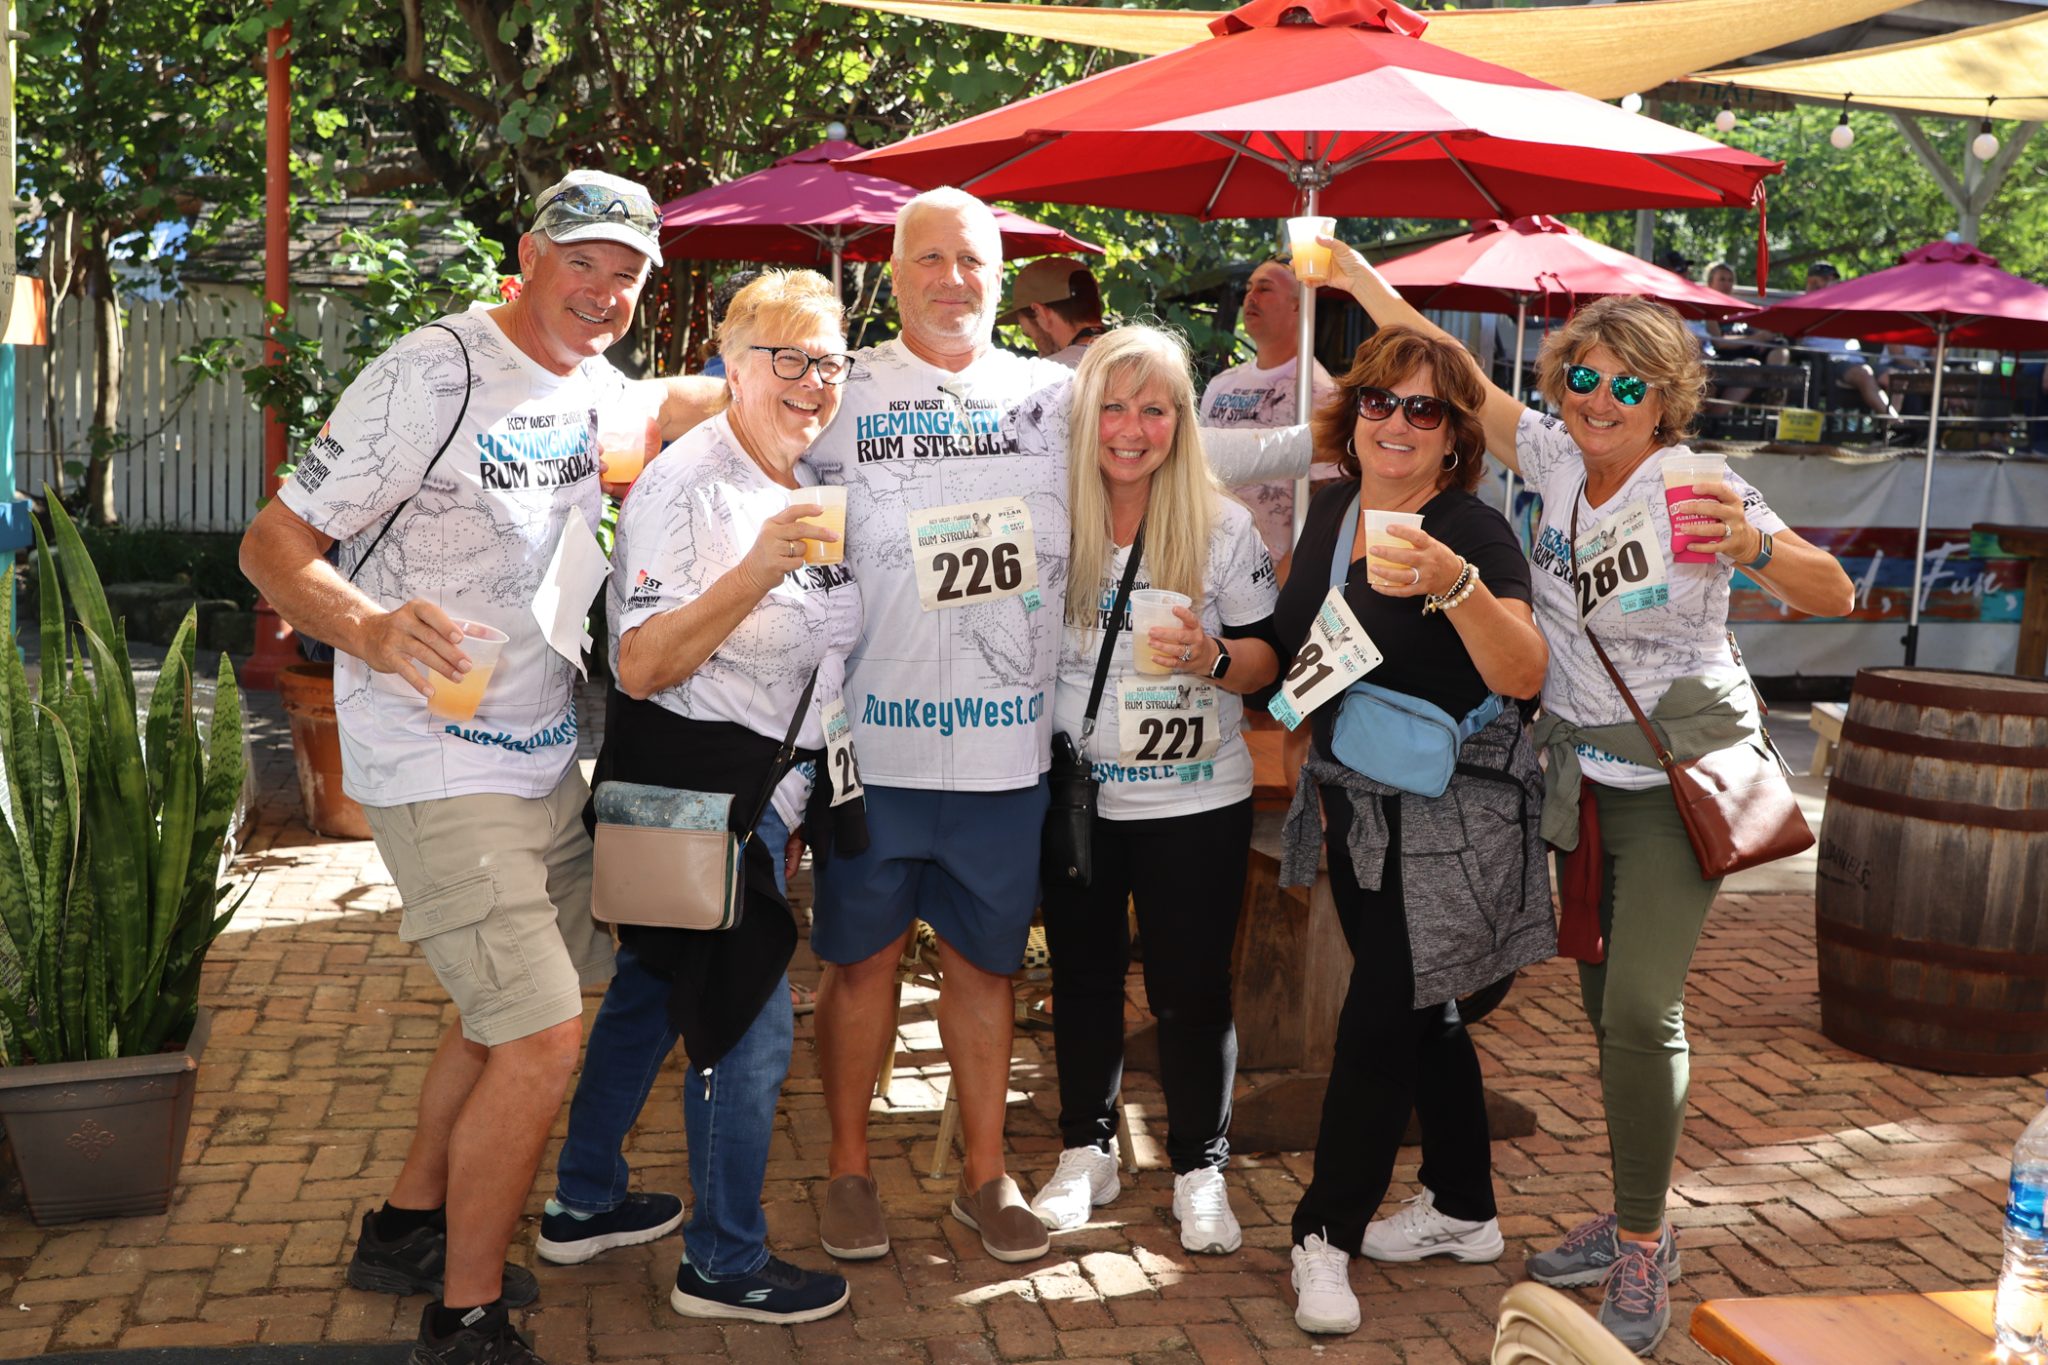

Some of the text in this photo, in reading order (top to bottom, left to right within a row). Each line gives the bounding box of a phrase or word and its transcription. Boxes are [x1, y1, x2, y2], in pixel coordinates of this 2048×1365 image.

[889, 400, 910, 411] KEY
[914, 399, 944, 410] WEST
[507, 417, 527, 430] KEY
[530, 414, 555, 428] WEST
[858, 433, 1001, 463] RUM STROLL
[480, 460, 529, 490] RUM
[998, 509, 1022, 518] PILAR
[918, 530, 972, 546] RUM STROLL
[1533, 543, 1555, 570] RUM
[932, 542, 1022, 602] 226
[1251, 562, 1272, 584] PIL
[1577, 540, 1649, 618] 280
[1286, 629, 1334, 700] 81
[1125, 700, 1176, 710] RUM STROLL
[1135, 716, 1204, 761] 227
